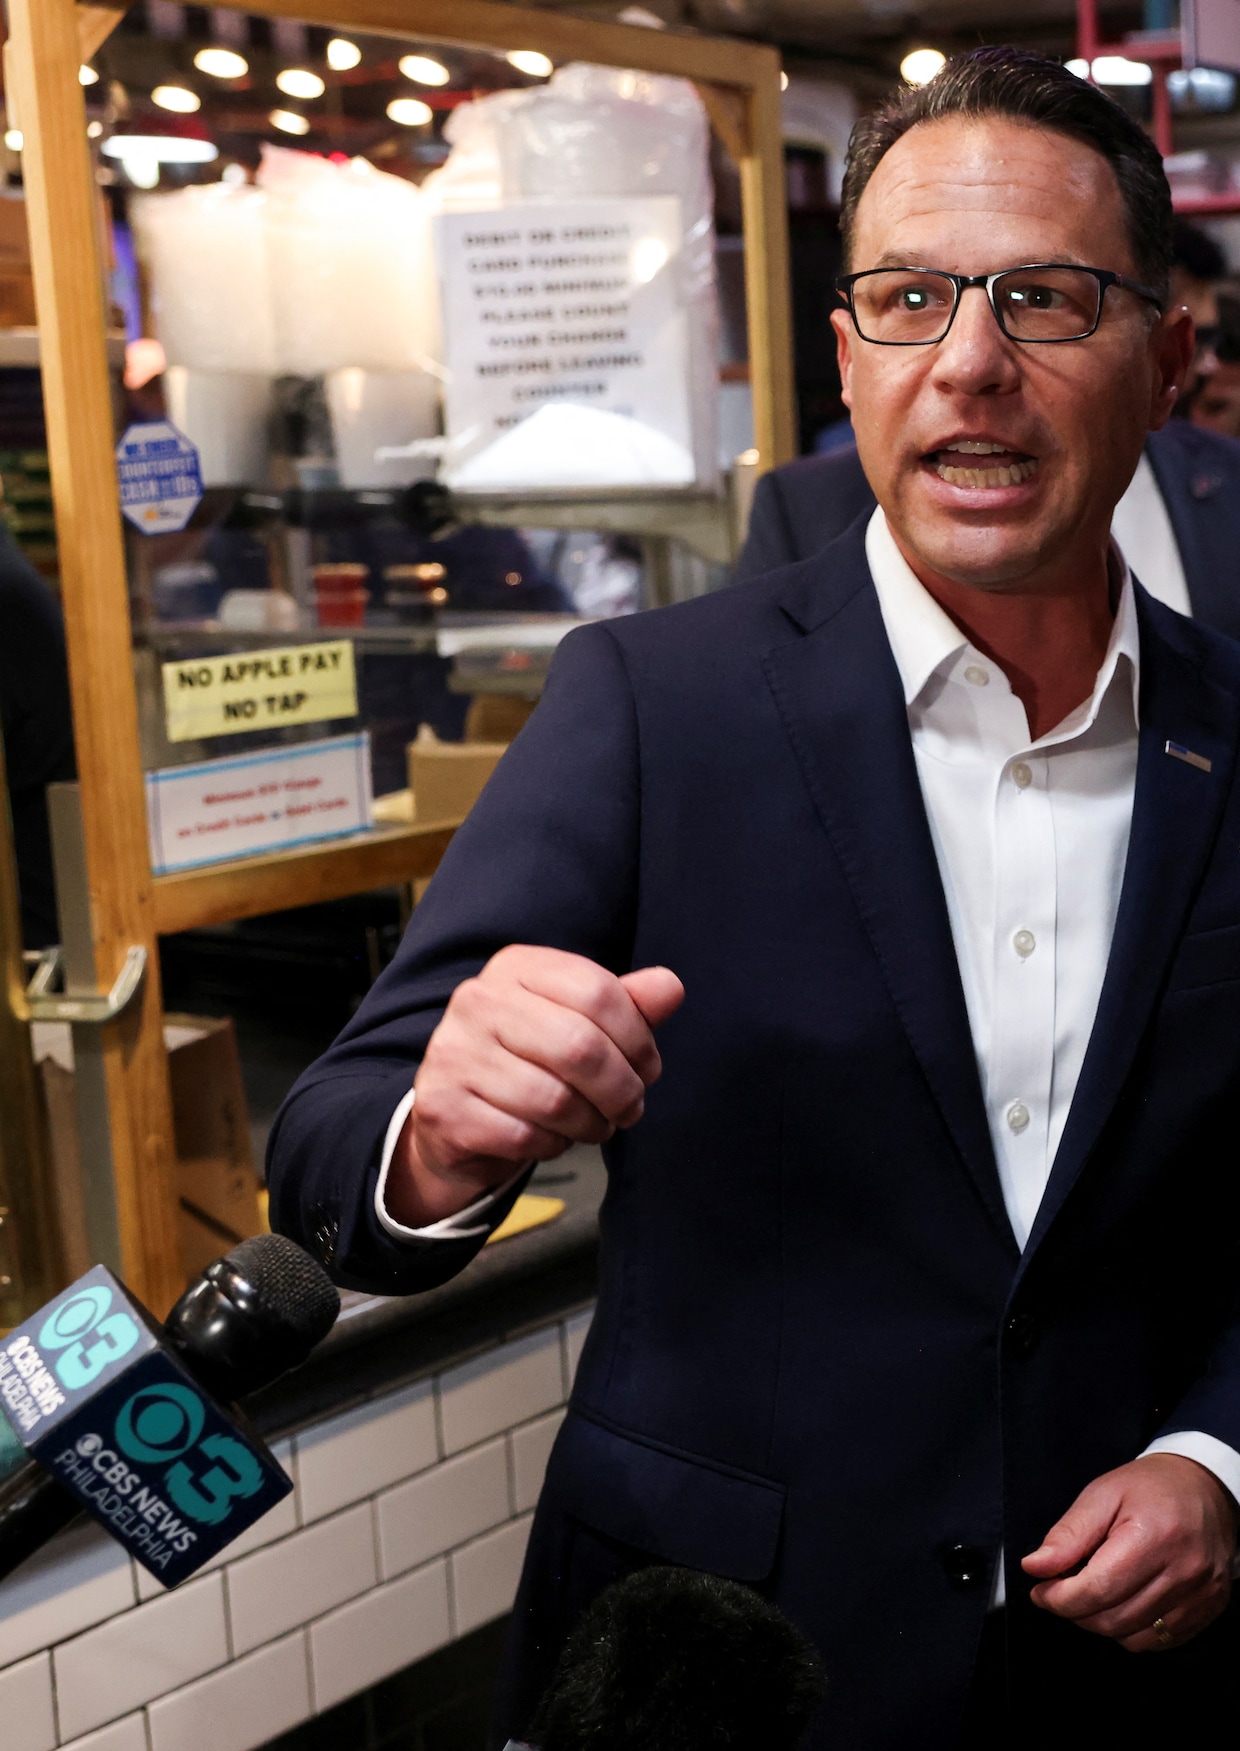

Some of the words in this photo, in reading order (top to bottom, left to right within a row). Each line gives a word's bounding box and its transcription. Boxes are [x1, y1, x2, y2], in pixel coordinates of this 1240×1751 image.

[464, 228, 521, 247] DEBIT
[560, 221, 630, 242] CREDIT
[469, 255, 520, 274] CARD
[480, 306, 555, 324] PLEASE
[487, 331, 541, 349] YOUR
[547, 325, 628, 344] CHANGE
[475, 356, 554, 378] BEFORE
[512, 380, 606, 400] COUNTER
[177, 668, 213, 689] NO
[220, 656, 293, 684] APPLE
[298, 648, 345, 674] PAY
[222, 700, 258, 719] NO
[264, 690, 308, 713] TAP
[26, 1366, 66, 1416] NEWS
[54, 1449, 174, 1570] PHILADELPHIA
[92, 1449, 141, 1495] CBS
[130, 1486, 198, 1552] NEWS
